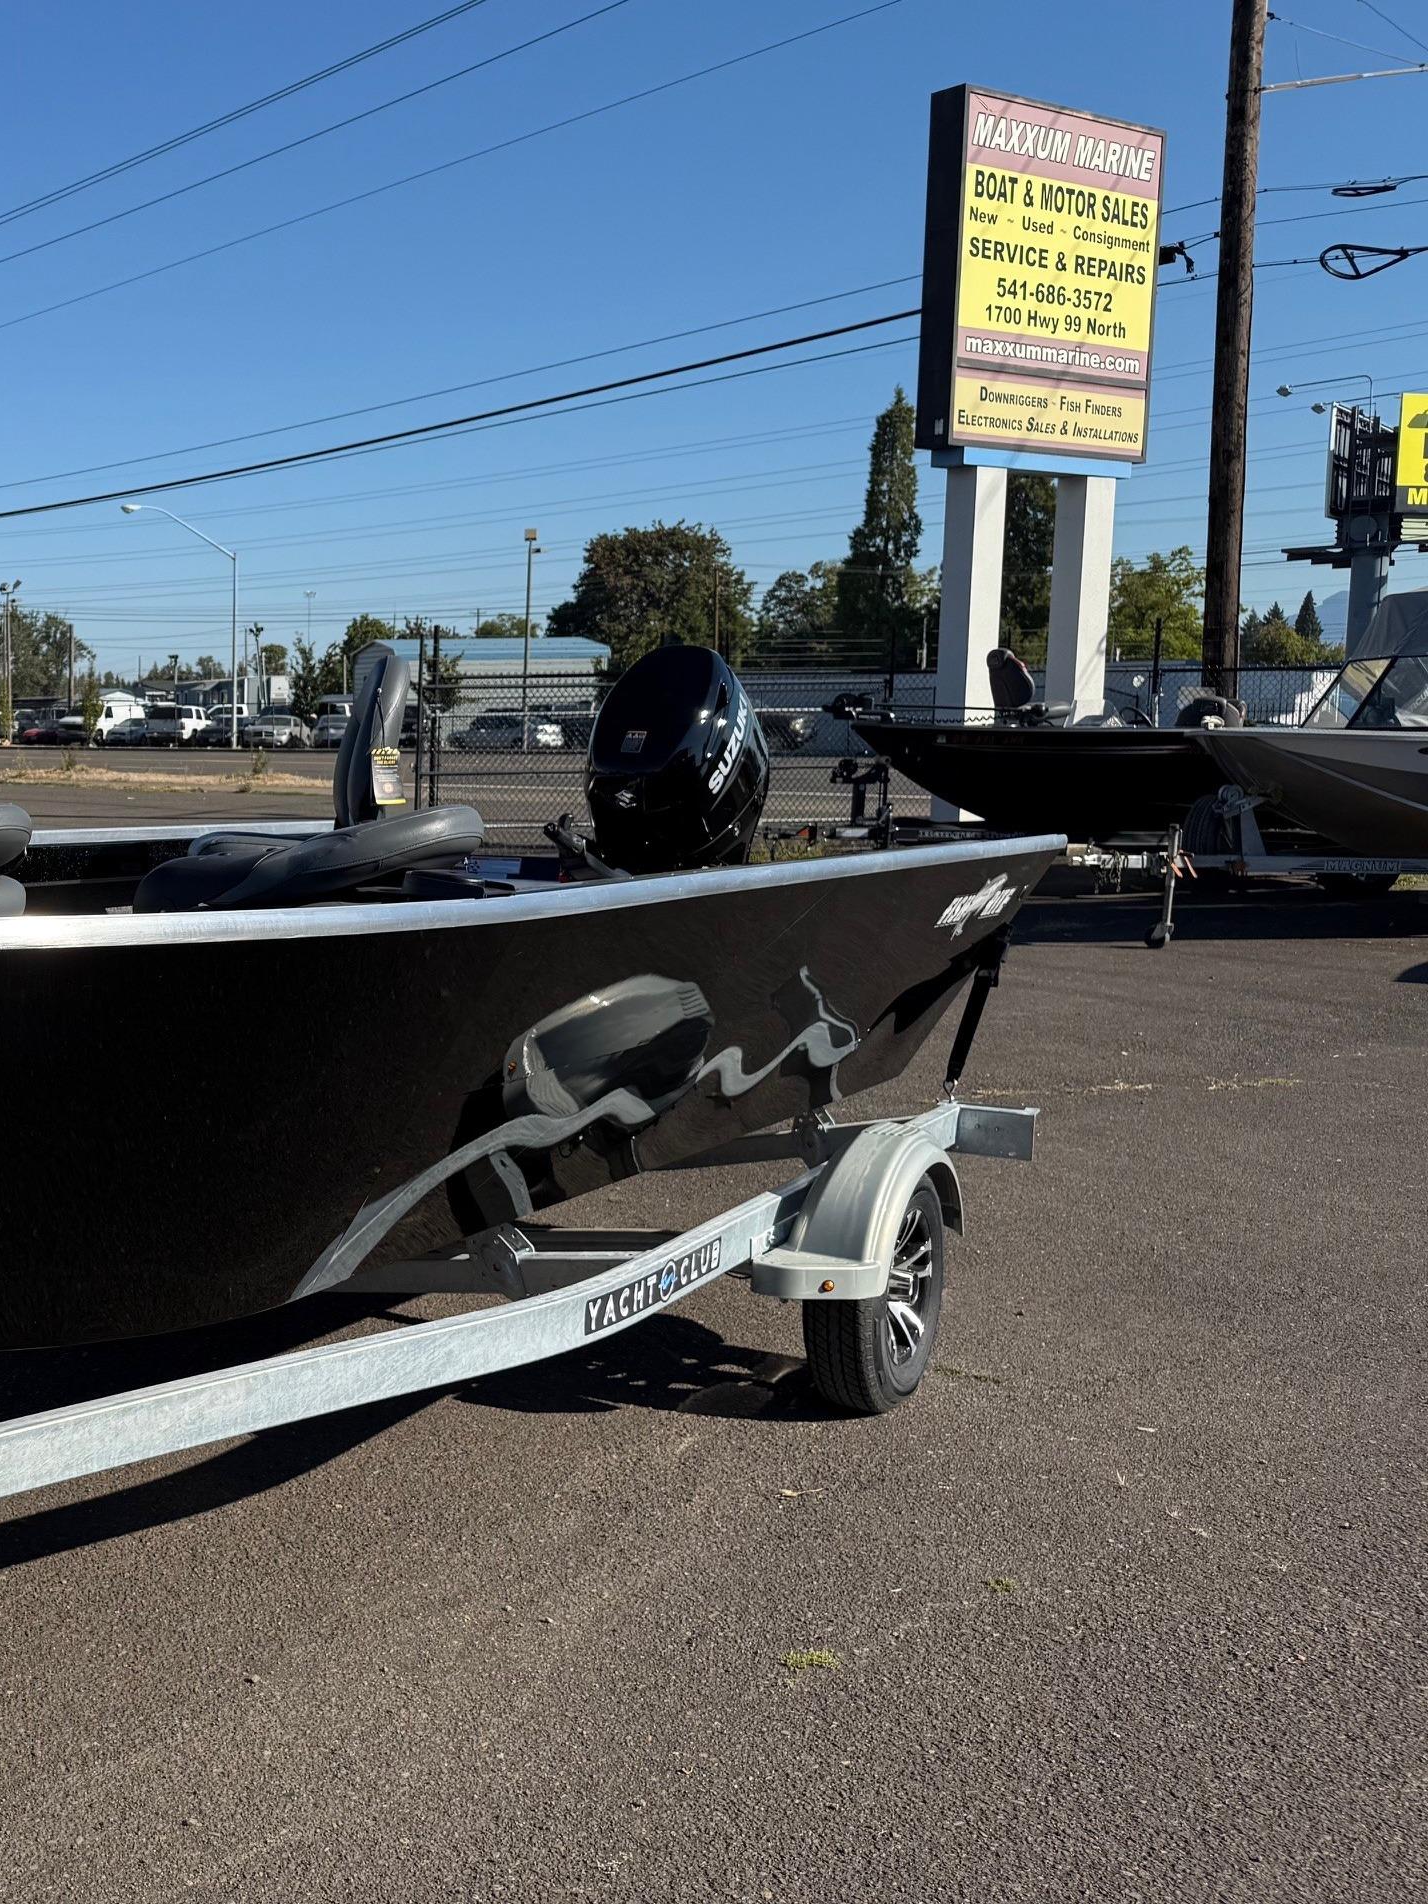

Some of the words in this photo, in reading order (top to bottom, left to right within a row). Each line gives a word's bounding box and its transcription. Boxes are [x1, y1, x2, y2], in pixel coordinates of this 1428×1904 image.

[972, 111, 1072, 164] MAXXUM
[1073, 134, 1156, 182] MARINE
[974, 169, 1018, 204] BOAT
[1023, 179, 1034, 208] &
[1040, 183, 1096, 220] MOTOR
[1101, 195, 1149, 230] SALES
[969, 205, 998, 225] New
[1022, 215, 1054, 235] Used
[1073, 225, 1150, 253] Consignment
[969, 237, 1049, 269] SERVICE
[1055, 251, 1067, 272] &
[1074, 254, 1146, 285] REPAIRS
[997, 277, 1113, 313] 541-686-3572
[985, 303, 1022, 325] 1700
[1027, 309, 1059, 334] Hwy
[1064, 314, 1082, 333] 99
[1087, 317, 1126, 339] North
[965, 335, 1140, 374] maxxummarine.com
[1060, 420, 1068, 436] &
[708, 692, 748, 795] SUZUKI
[1327, 860, 1398, 872] MAGNUM
[588, 1273, 657, 1331] YACHT
[680, 1239, 721, 1285] CLUB
